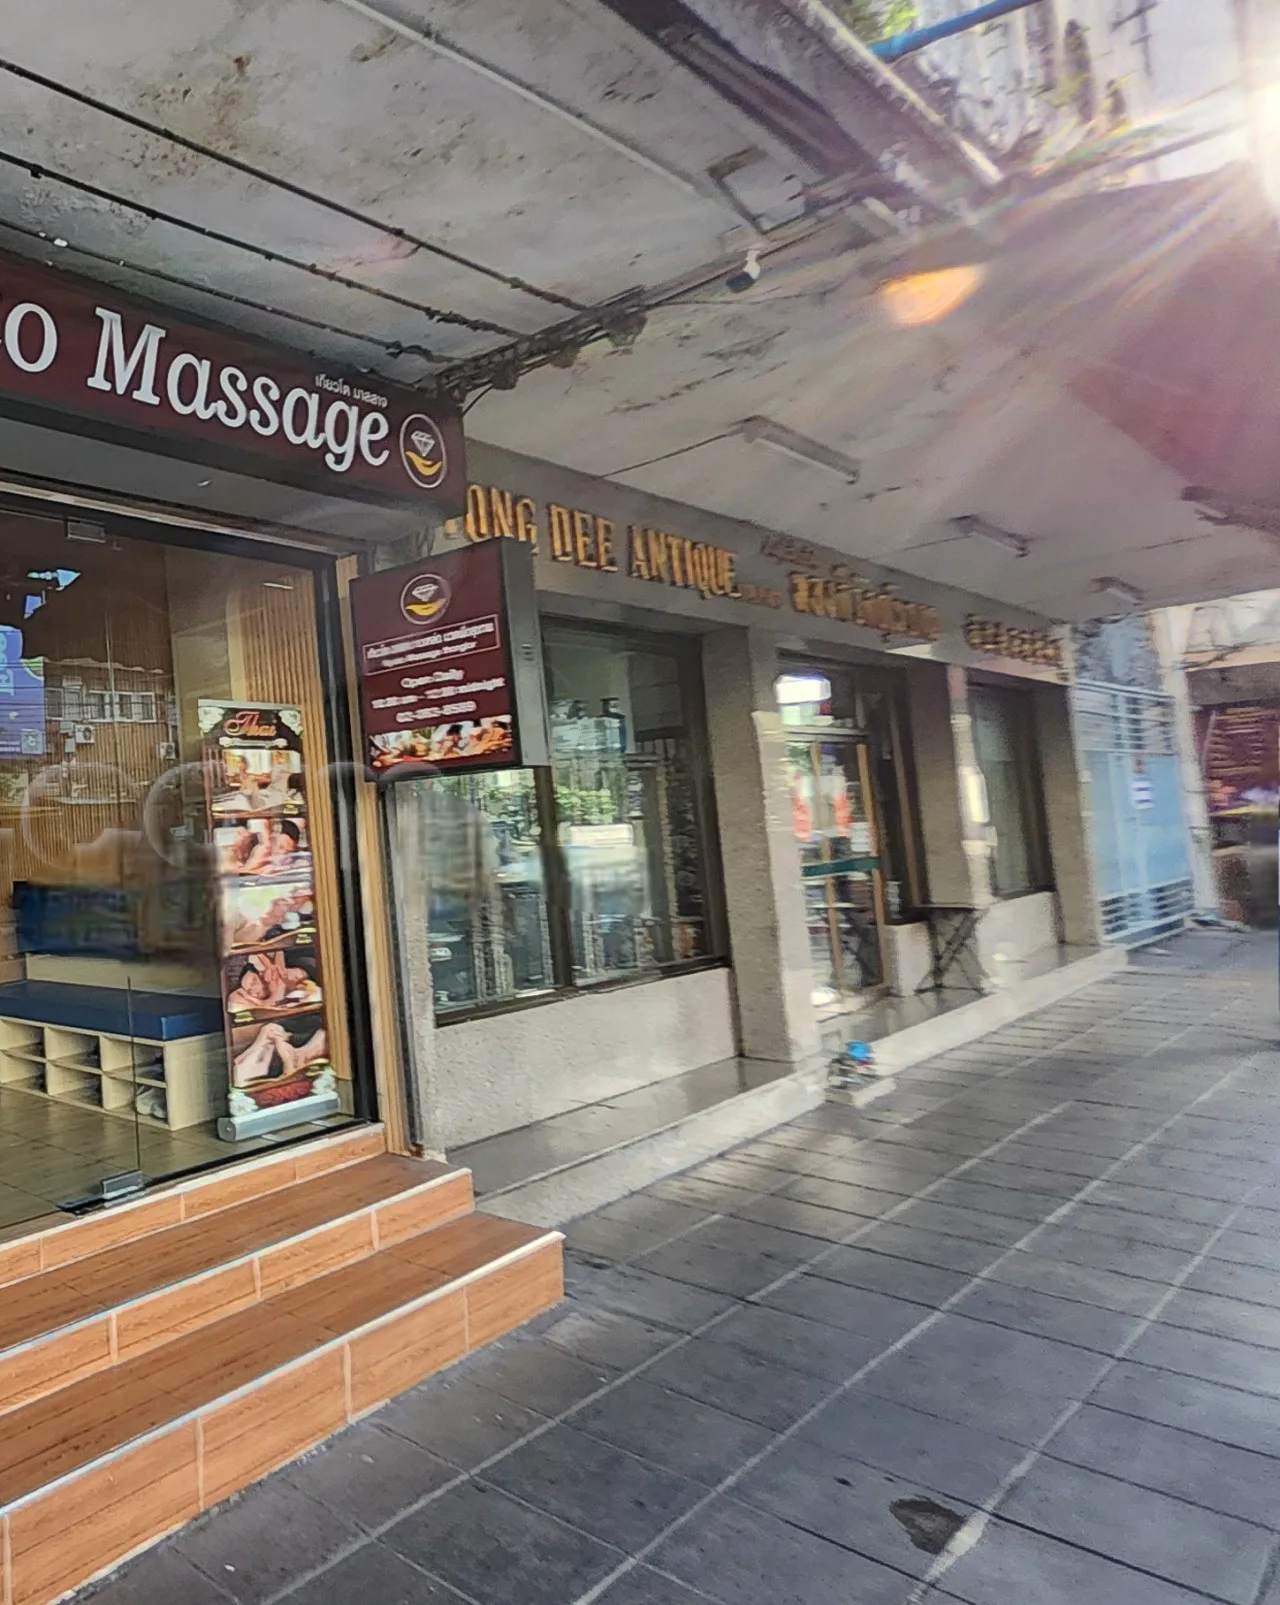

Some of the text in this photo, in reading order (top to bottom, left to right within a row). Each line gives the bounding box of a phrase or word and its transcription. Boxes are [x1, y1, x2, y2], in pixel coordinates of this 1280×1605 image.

[87, 306, 392, 472] Massage
[444, 483, 540, 556] ONG
[547, 503, 619, 573] DEE
[627, 523, 743, 601] ANTIQUE
[223, 711, 277, 737] Thai
